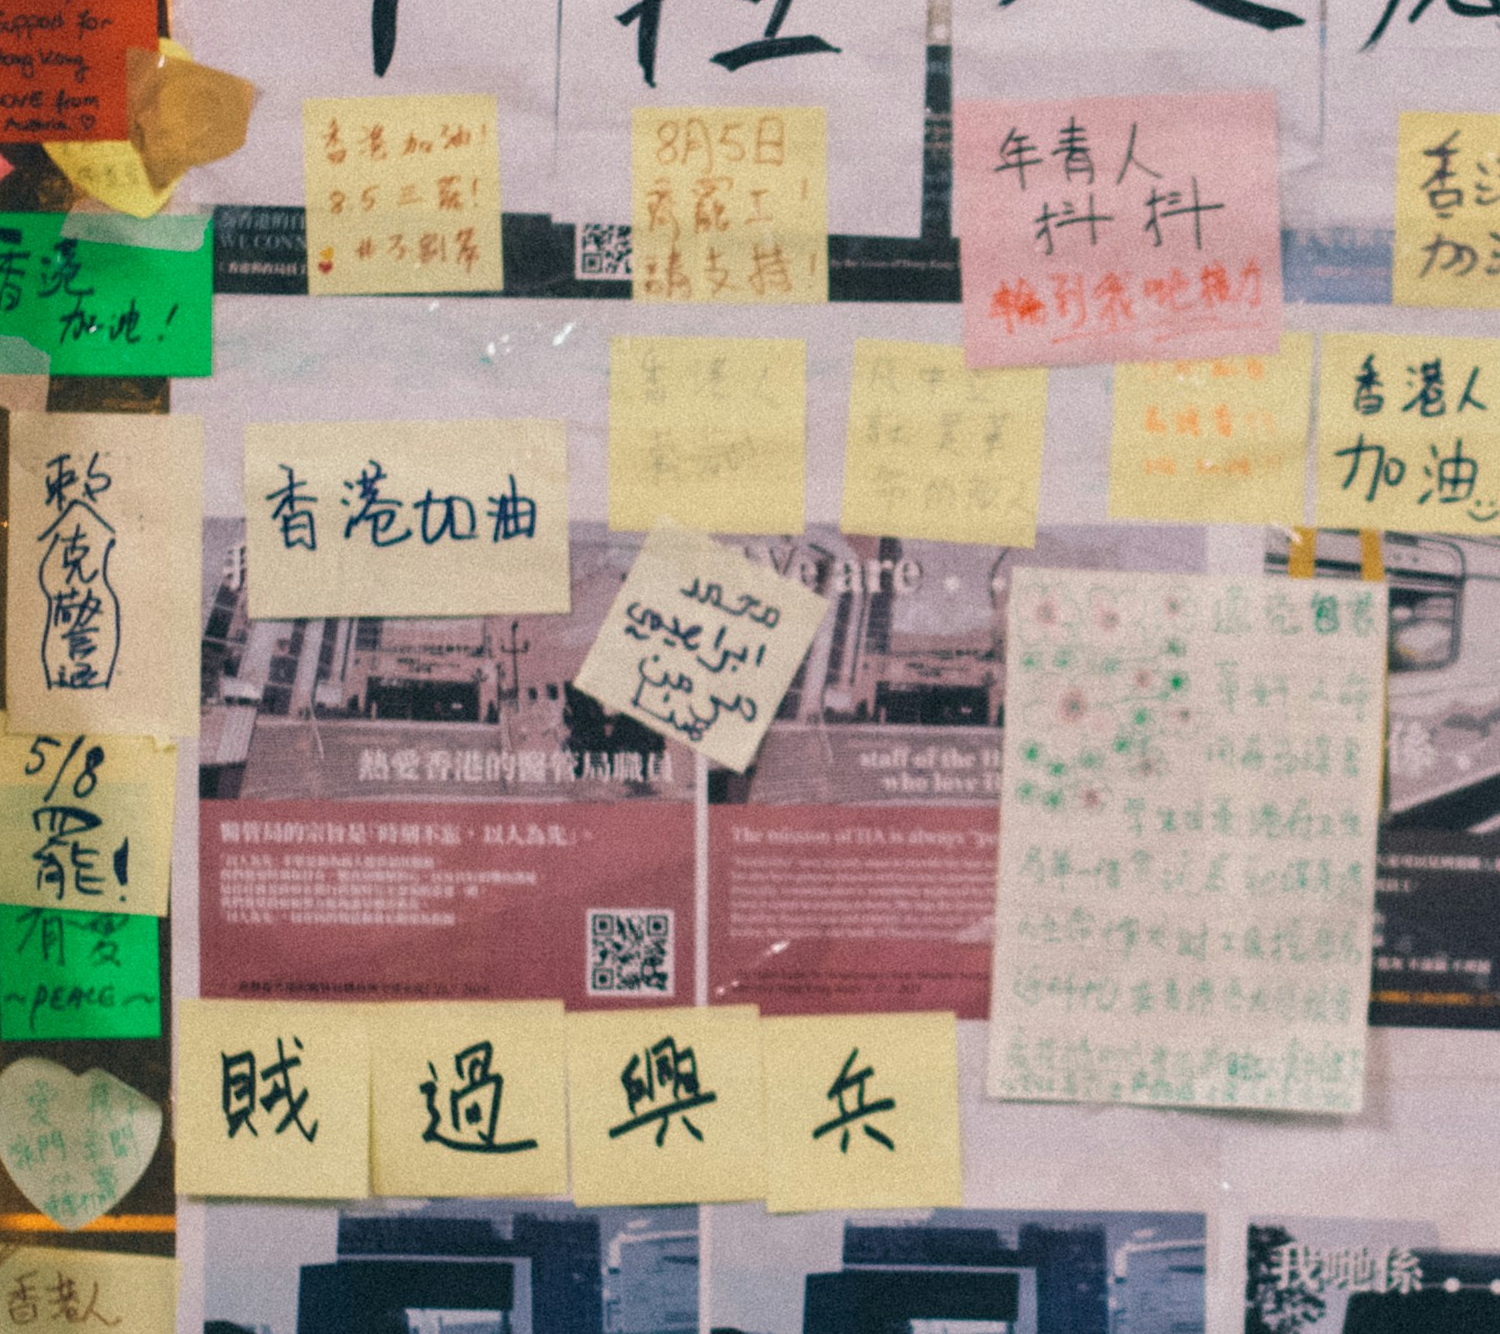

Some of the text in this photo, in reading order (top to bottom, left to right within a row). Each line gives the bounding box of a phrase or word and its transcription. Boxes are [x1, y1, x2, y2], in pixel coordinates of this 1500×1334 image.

[655, 117, 789, 173] 8月5日
[998, 116, 1164, 191] 年青人
[1033, 175, 1226, 252] 抖抖
[58, 300, 180, 350] 加油!
[1346, 351, 1489, 421] 香港人
[264, 455, 538, 551] 香港加油
[1331, 434, 1486, 509] 加油
[27, 736, 106, 802] 5/8
[219, 1033, 898, 1153] 賊過興兵
